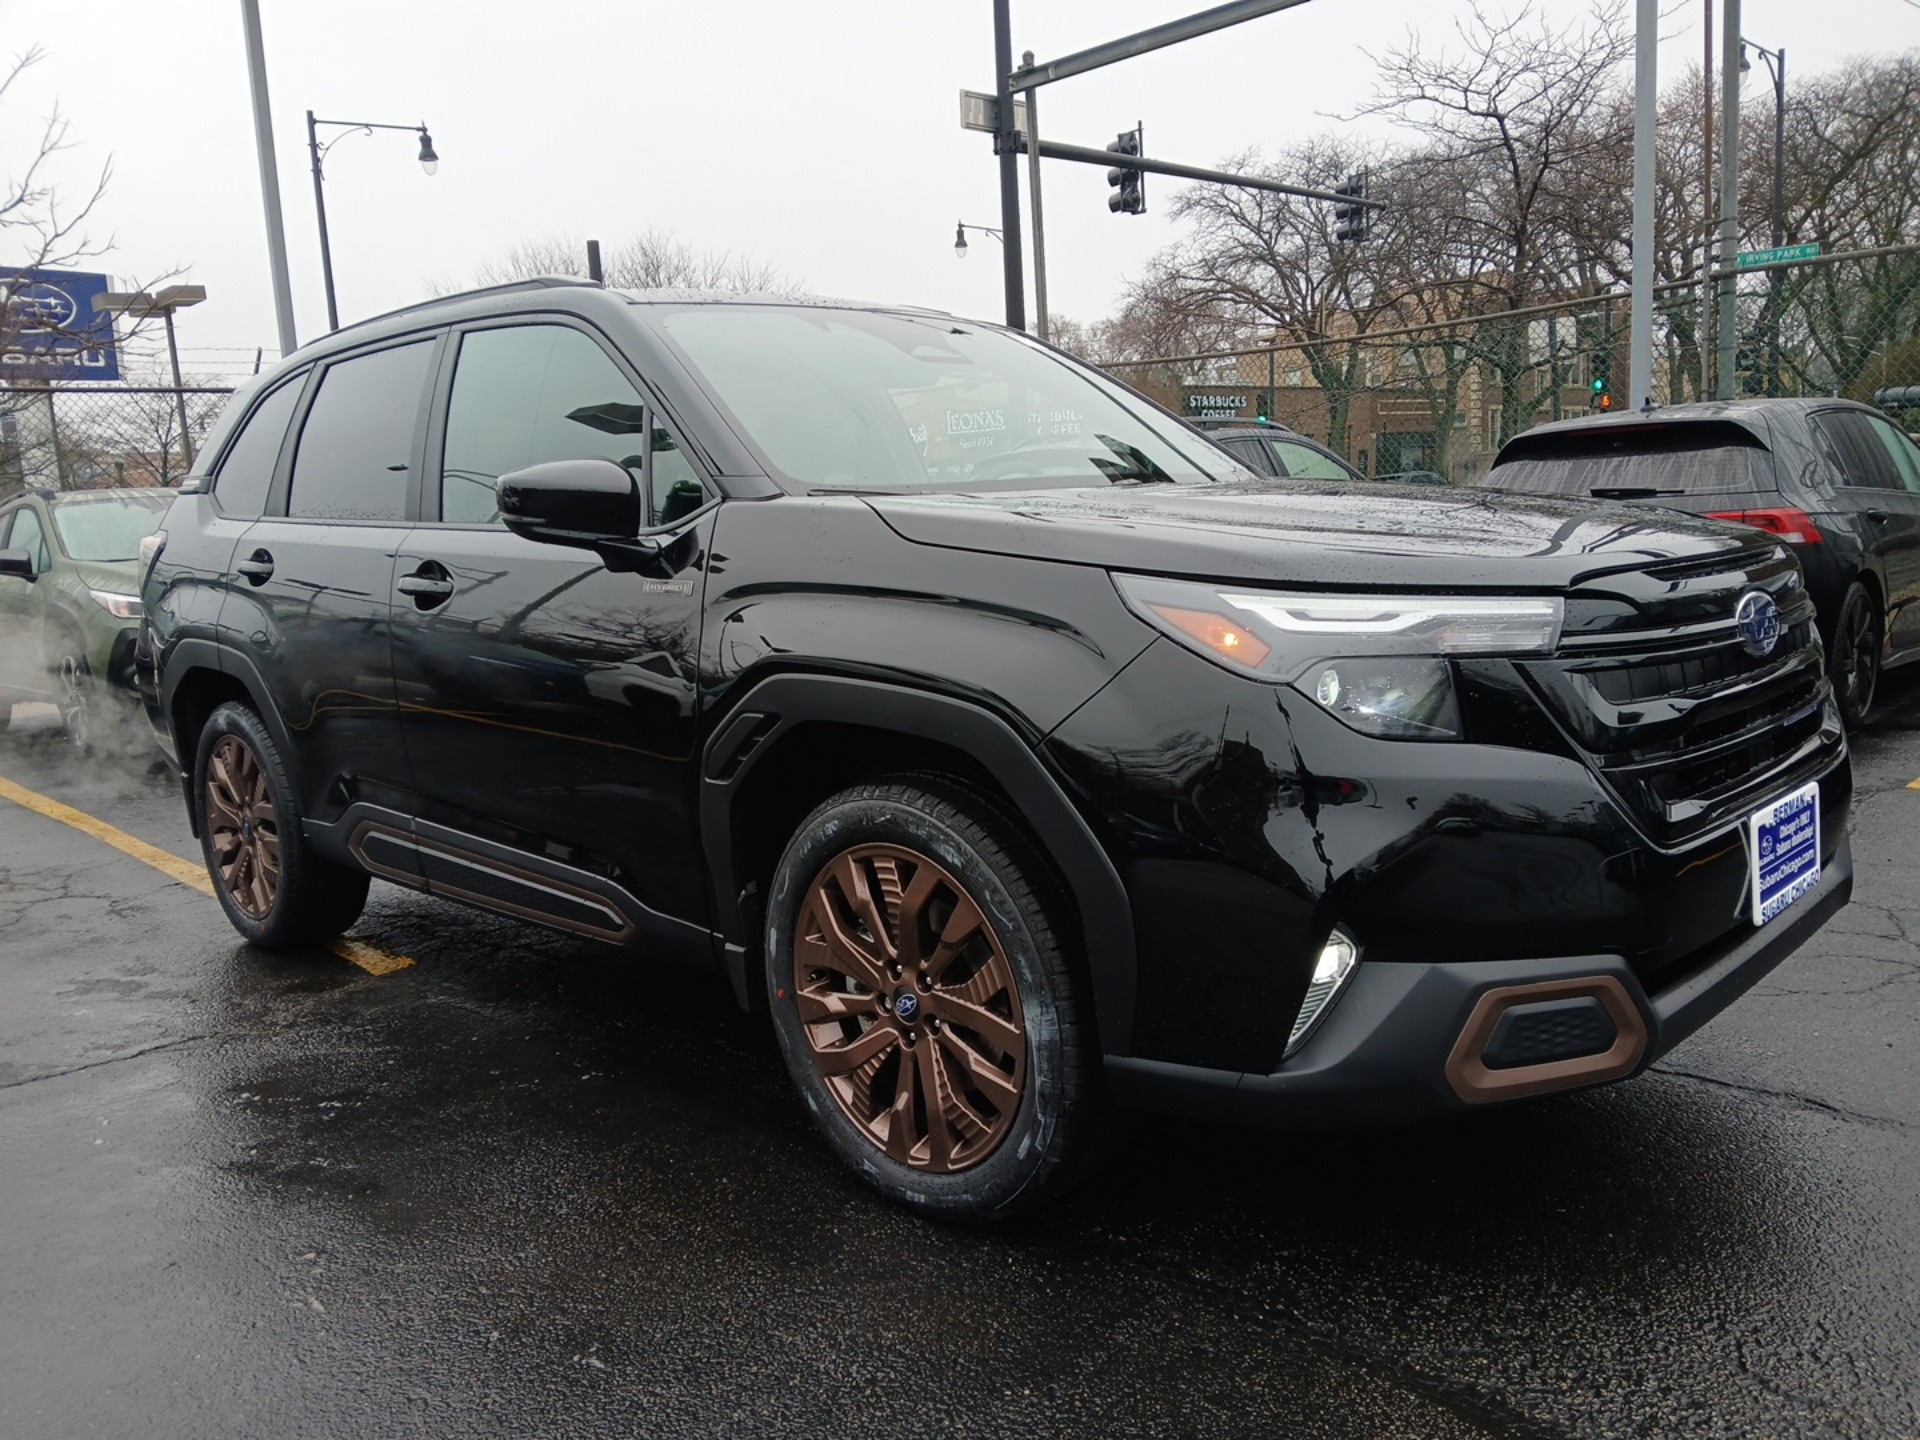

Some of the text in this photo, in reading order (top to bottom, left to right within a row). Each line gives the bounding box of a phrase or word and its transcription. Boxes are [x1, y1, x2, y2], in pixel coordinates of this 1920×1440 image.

[1746, 251, 1775, 263] IRVING
[1776, 248, 1801, 260] PARK
[1190, 395, 1247, 408] STARBUCKS
[946, 410, 1005, 434] LEONA'S
[650, 583, 683, 592] HYBRID
[1773, 792, 1806, 824] BERMAN
[1762, 868, 1820, 923] SUBARU CHICAGO
